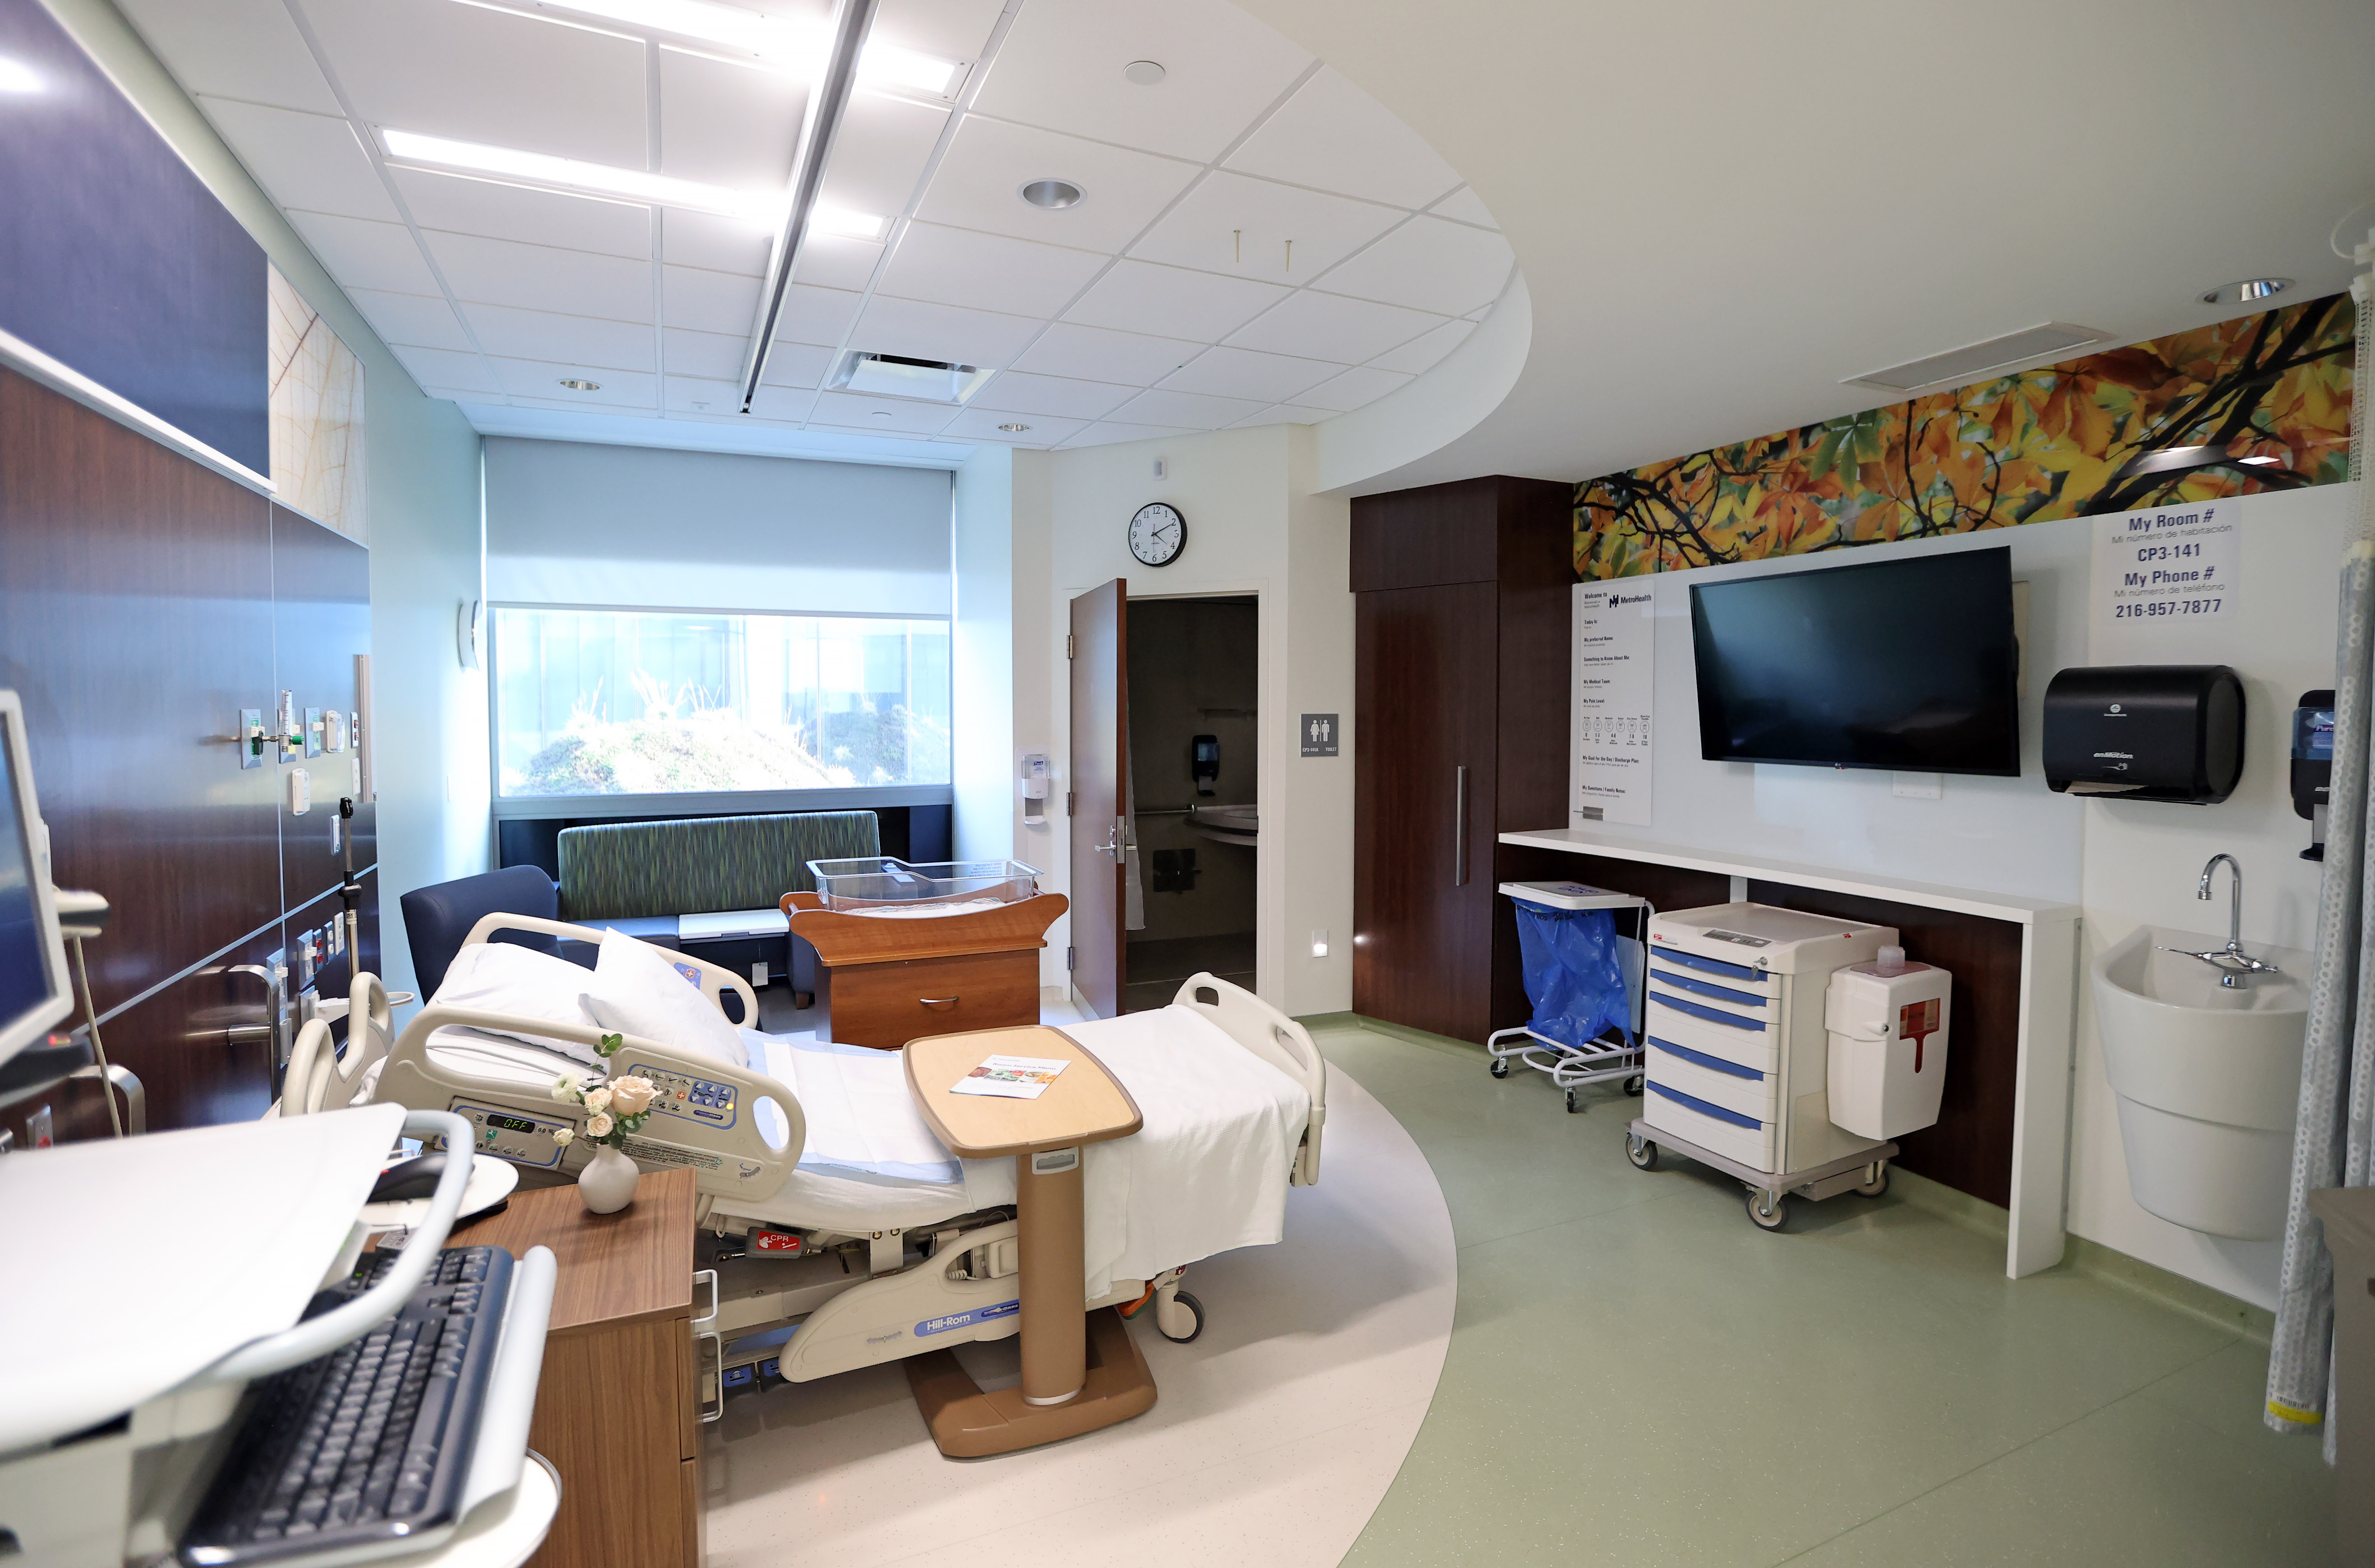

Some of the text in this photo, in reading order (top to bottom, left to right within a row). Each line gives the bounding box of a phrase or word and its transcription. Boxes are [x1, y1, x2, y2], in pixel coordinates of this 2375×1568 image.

[2129, 508, 2214, 532] My Room #
[1132, 531, 1137, 539] 9
[2112, 524, 2232, 544] Mi número de habitación
[2138, 543, 2200, 562] CP3-141
[2125, 566, 2215, 587] My Phone #
[1621, 594, 1651, 604] MetroHealth
[2129, 587, 2165, 596] número
[2184, 583, 2225, 592] teléfono
[2116, 599, 2222, 618] 216-957-7877
[927, 1314, 970, 1331] Hill-Rom
